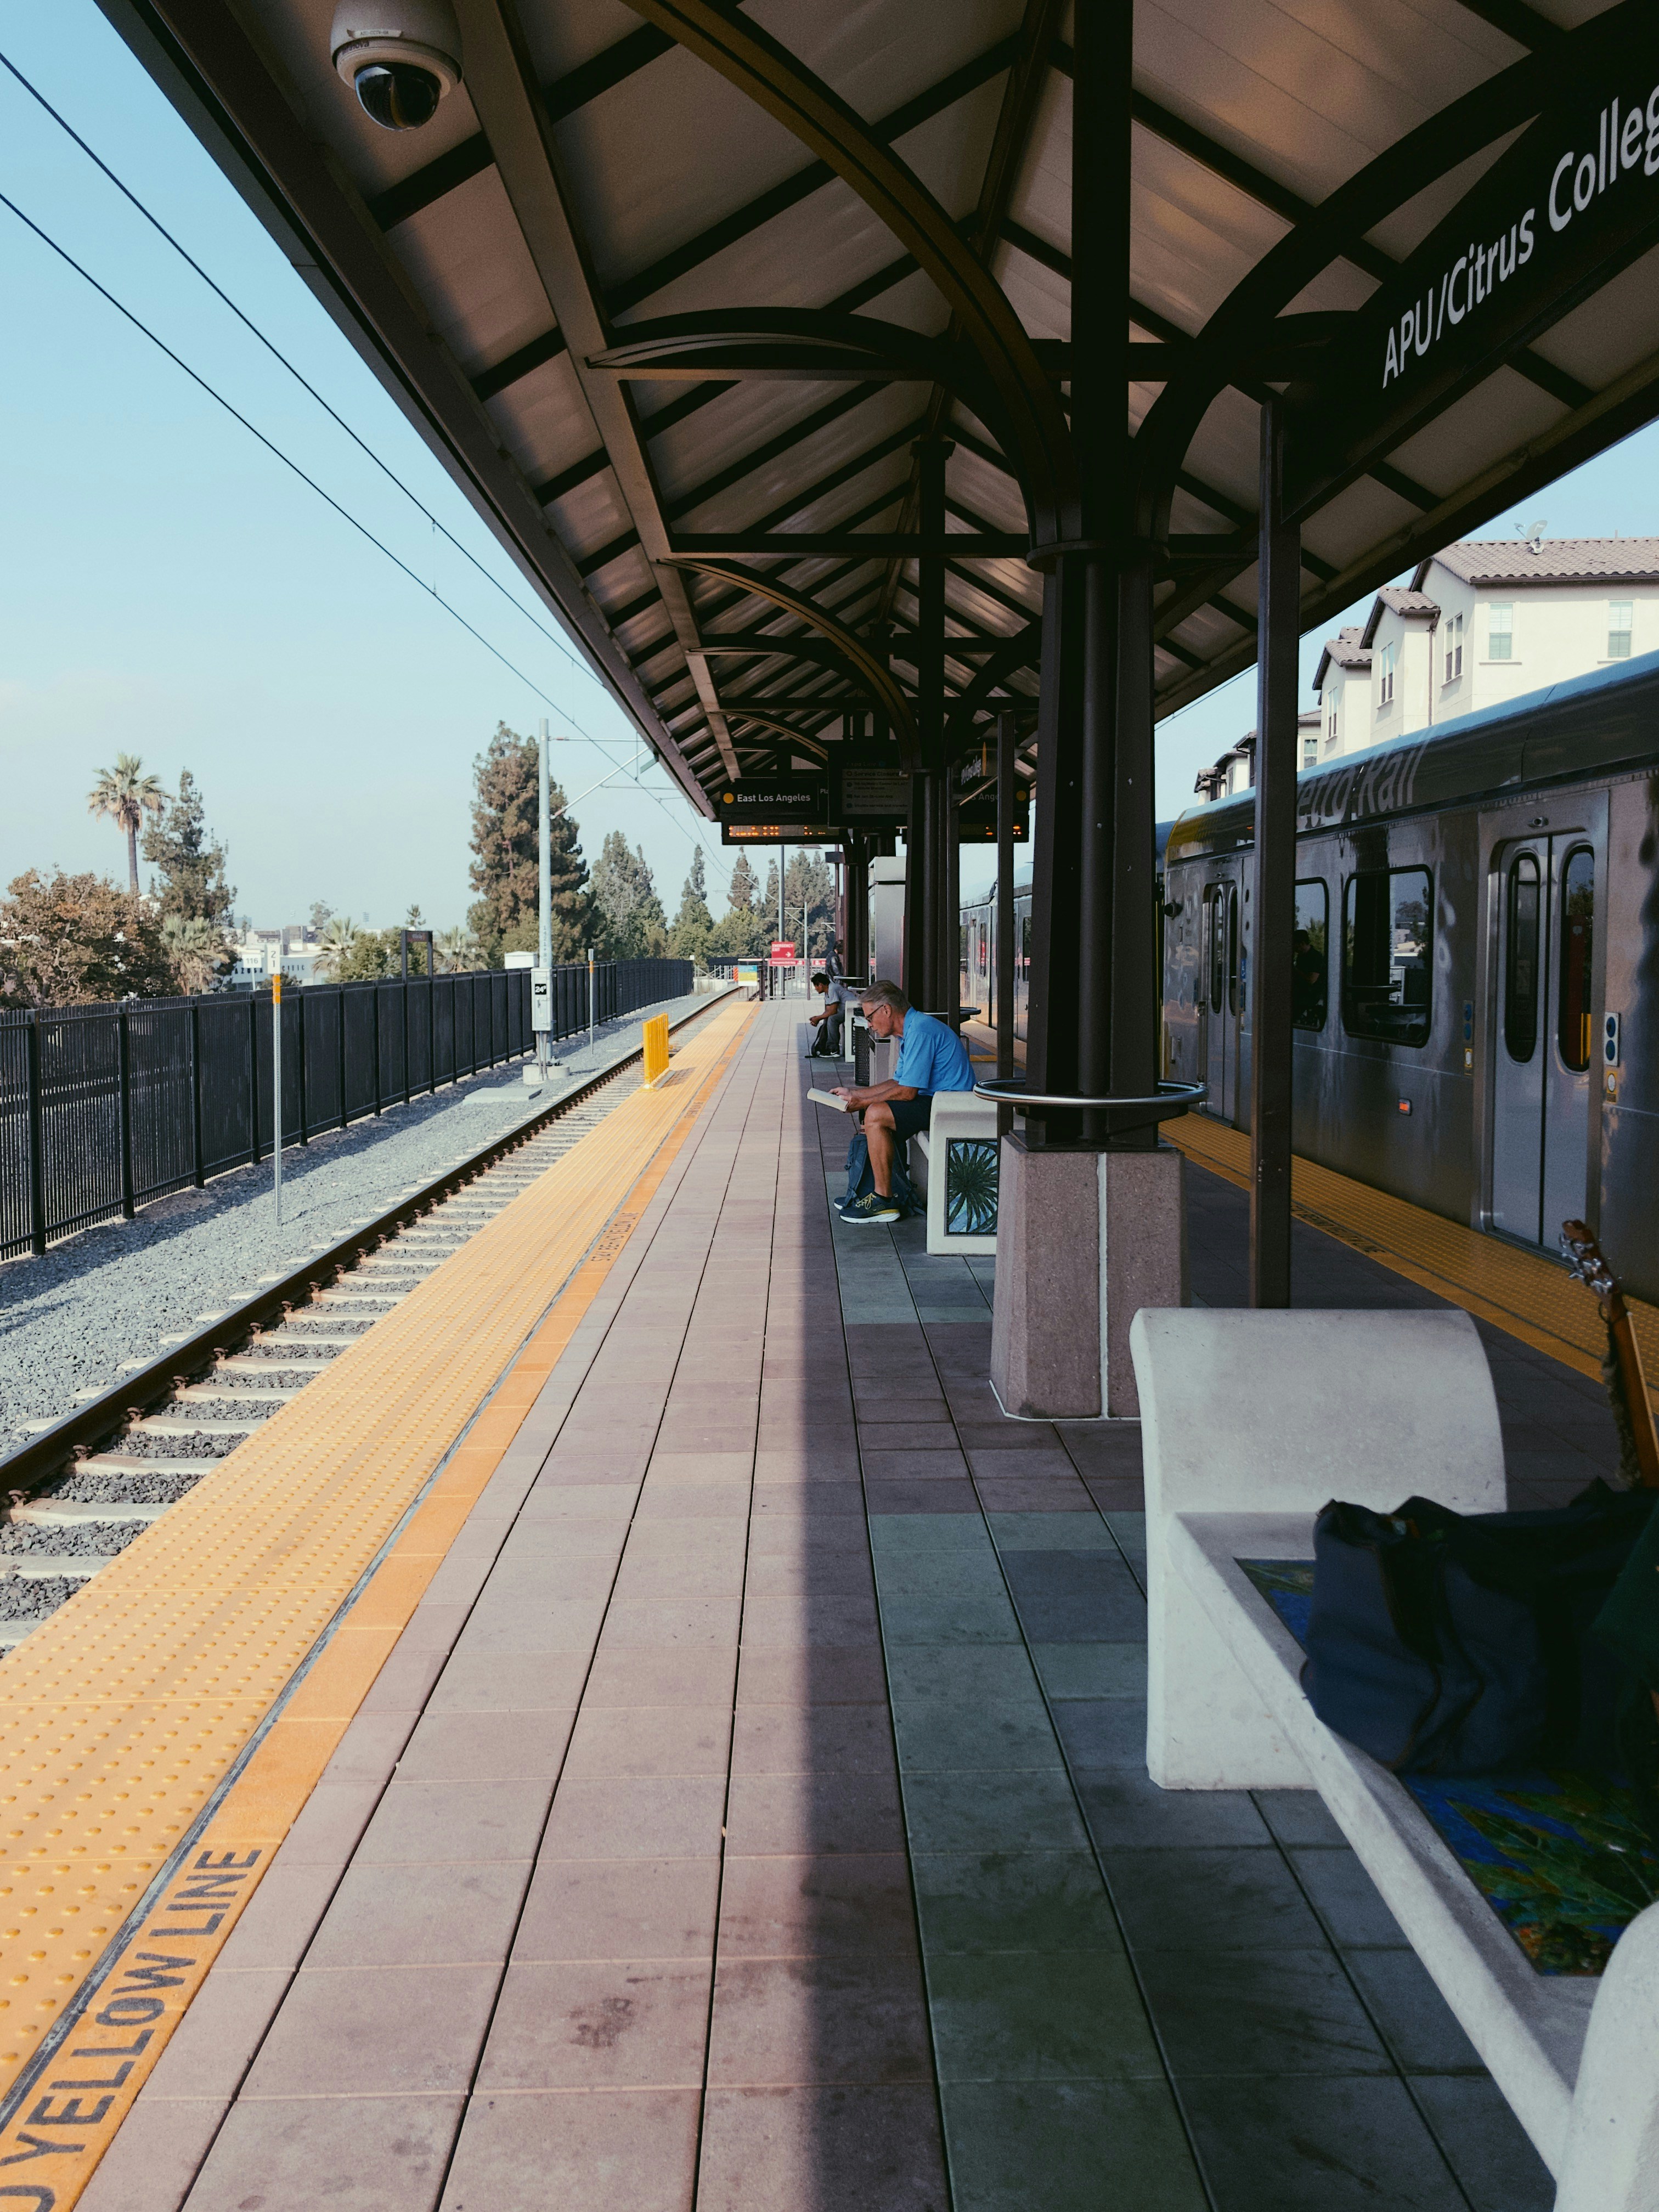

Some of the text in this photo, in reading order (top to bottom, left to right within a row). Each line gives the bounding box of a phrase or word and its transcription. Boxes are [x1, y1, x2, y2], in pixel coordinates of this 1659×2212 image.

[1382, 84, 1659, 390] APU/Citrus Colleg
[737, 793, 811, 803] East Los Angeles
[1296, 766, 1356, 828] etro
[0, 1849, 262, 2167] YELLOW LINE
